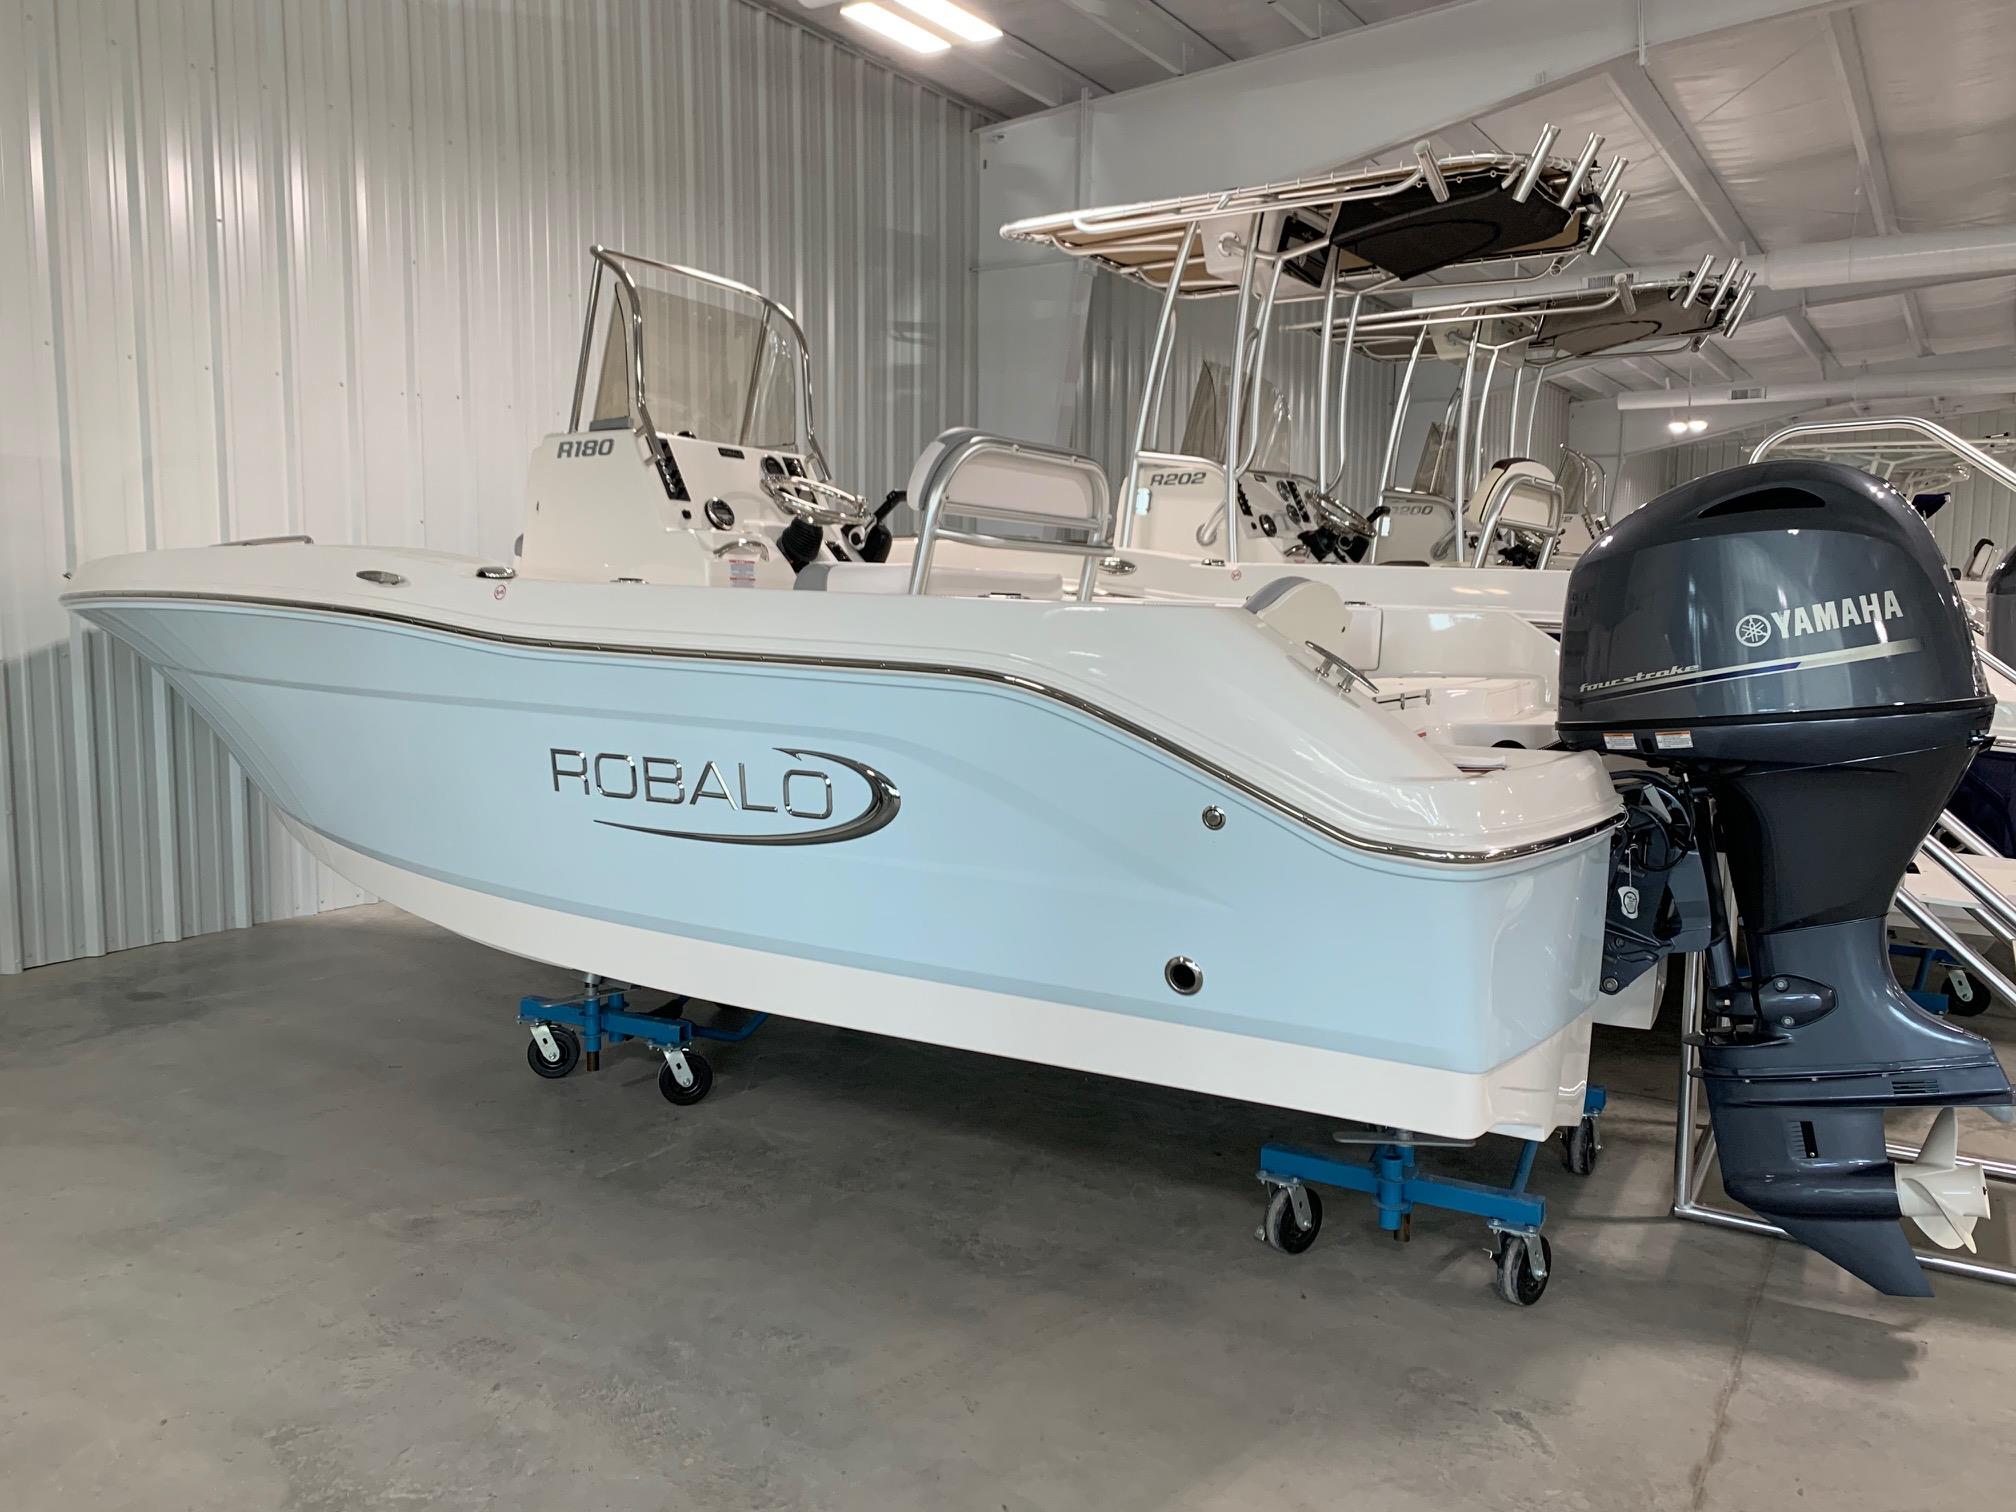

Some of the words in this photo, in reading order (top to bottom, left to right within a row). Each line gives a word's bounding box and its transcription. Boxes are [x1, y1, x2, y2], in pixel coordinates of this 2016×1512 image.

[557, 438, 615, 459] R180
[1150, 471, 1207, 486] R202
[1770, 589, 1904, 639] YAMAHA
[550, 748, 833, 819] ROBALO
